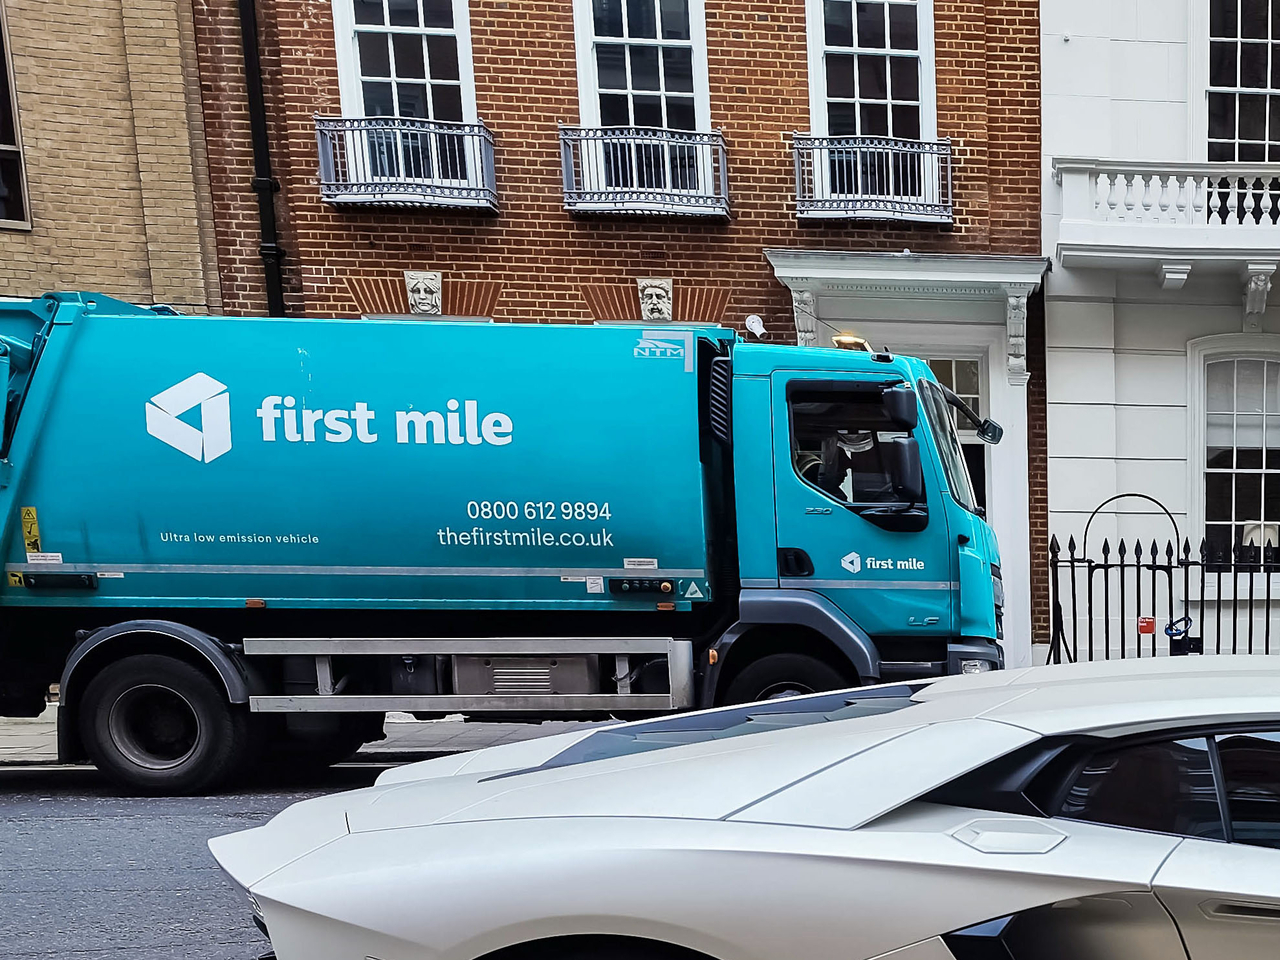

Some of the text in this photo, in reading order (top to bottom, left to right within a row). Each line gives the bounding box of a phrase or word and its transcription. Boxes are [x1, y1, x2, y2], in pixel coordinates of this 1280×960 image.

[634, 347, 684, 357] NTM
[257, 395, 513, 446] first mile
[467, 500, 612, 521] 0800 612 9894
[805, 507, 833, 515] 230
[160, 532, 320, 544] Ultra low emission vehicle
[436, 526, 614, 547] thefirstmile.co.uk
[866, 557, 925, 570] first mile
[908, 616, 940, 626] LF
